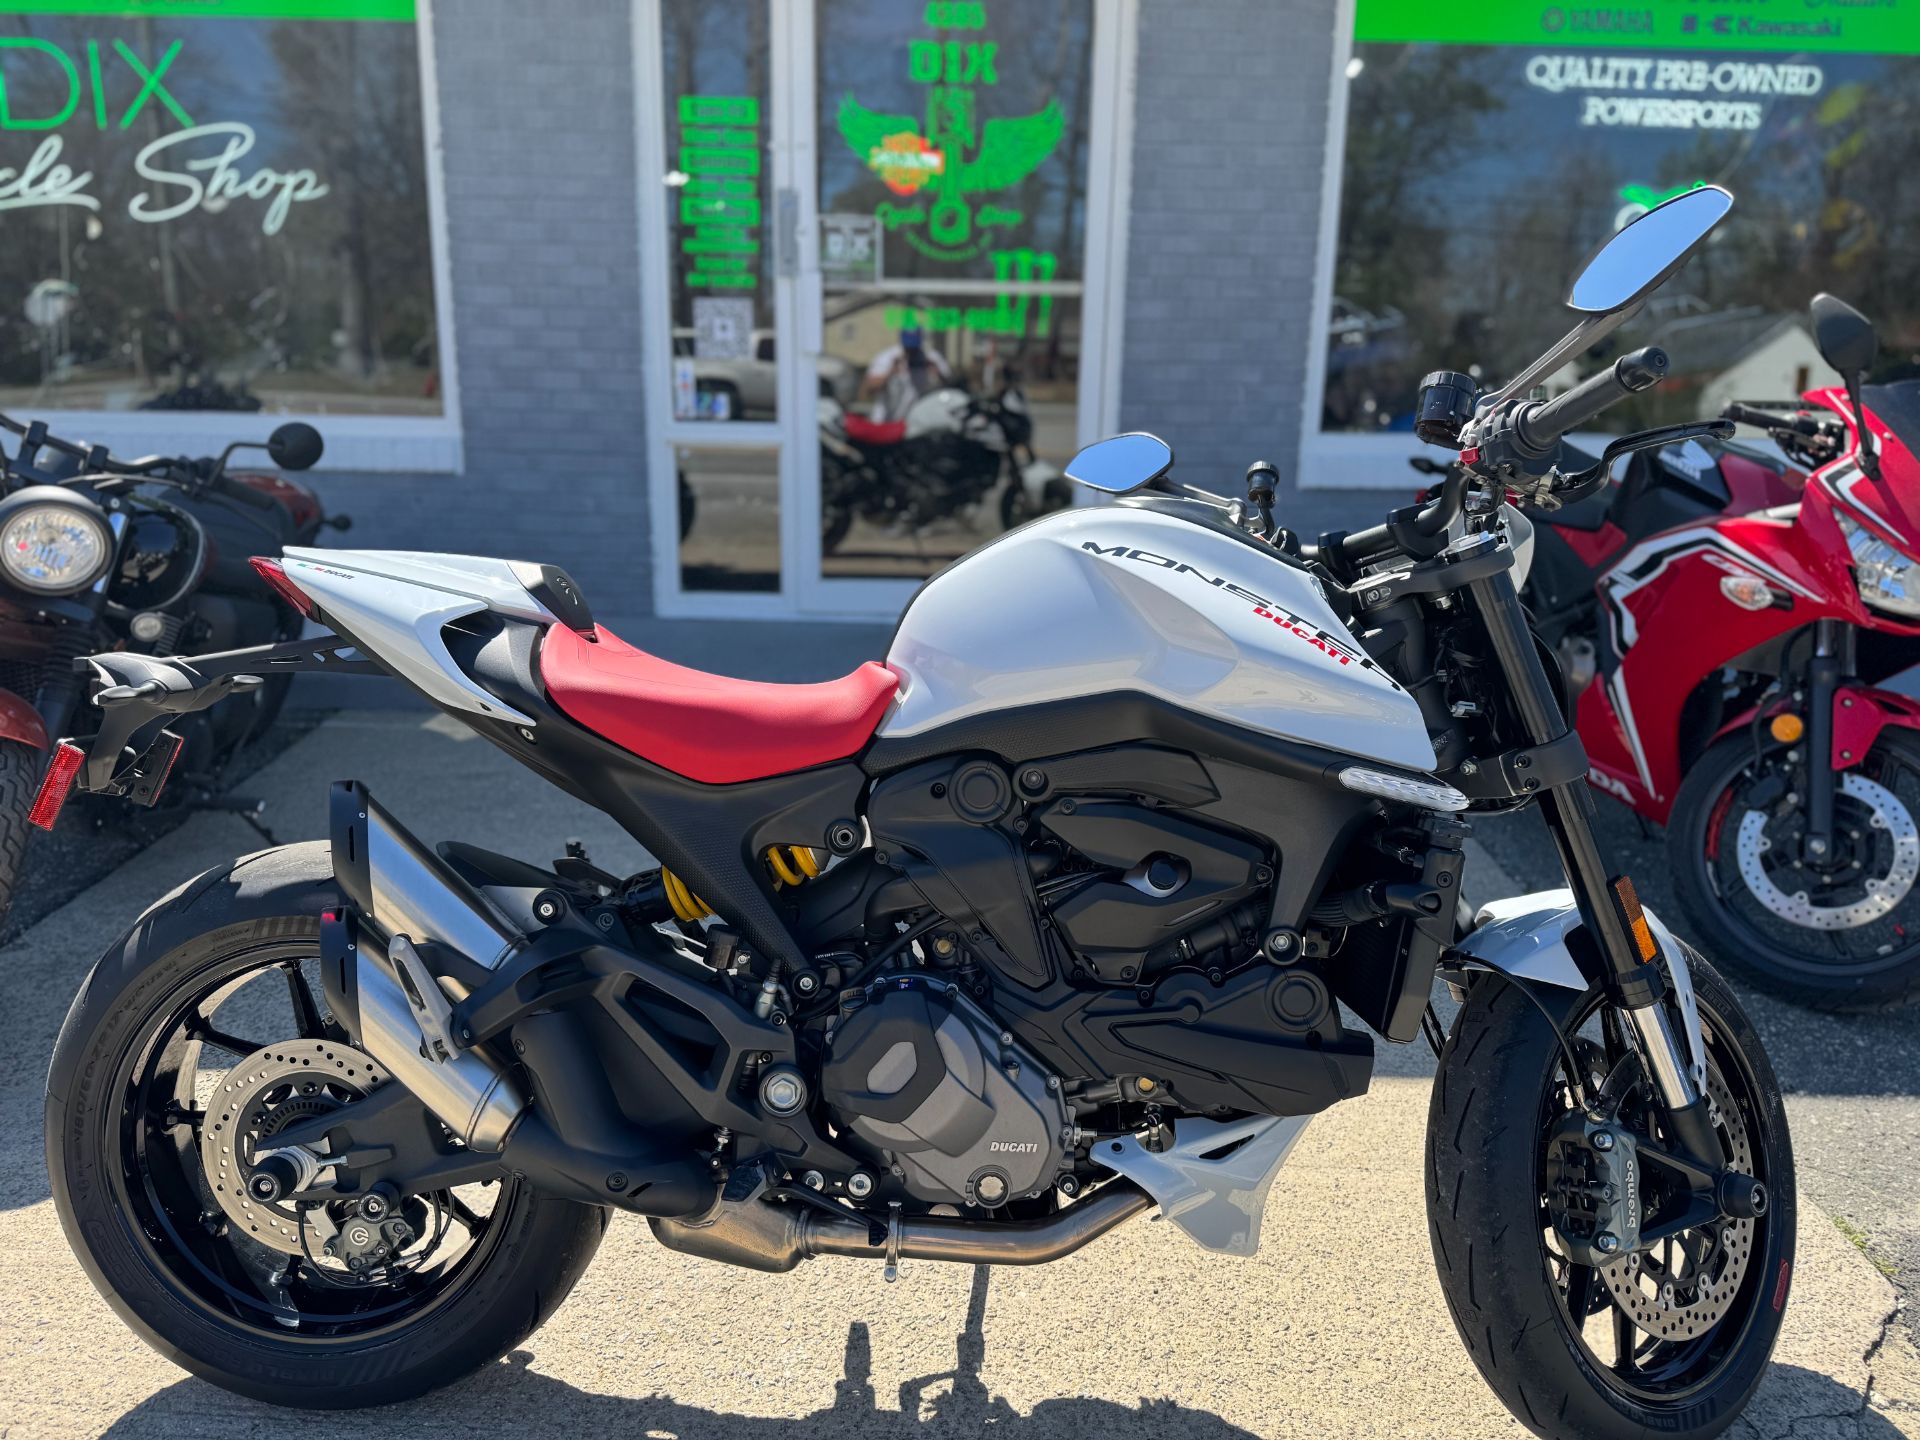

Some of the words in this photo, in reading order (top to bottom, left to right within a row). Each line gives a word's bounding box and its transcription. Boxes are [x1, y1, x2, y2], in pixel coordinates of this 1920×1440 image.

[0, 36, 196, 130] DIX
[909, 40, 999, 84] DIX
[1526, 55, 1652, 92] QUALITY
[1654, 59, 1823, 95] PRE-OWNED
[1582, 96, 1763, 130] POWERSPORTS
[129, 121, 330, 236] Shop
[1081, 541, 1401, 691] MONSTER
[1253, 606, 1350, 666] DUCATI
[990, 1141, 1038, 1153] DUCATI
[1625, 1160, 1637, 1228] brembo
